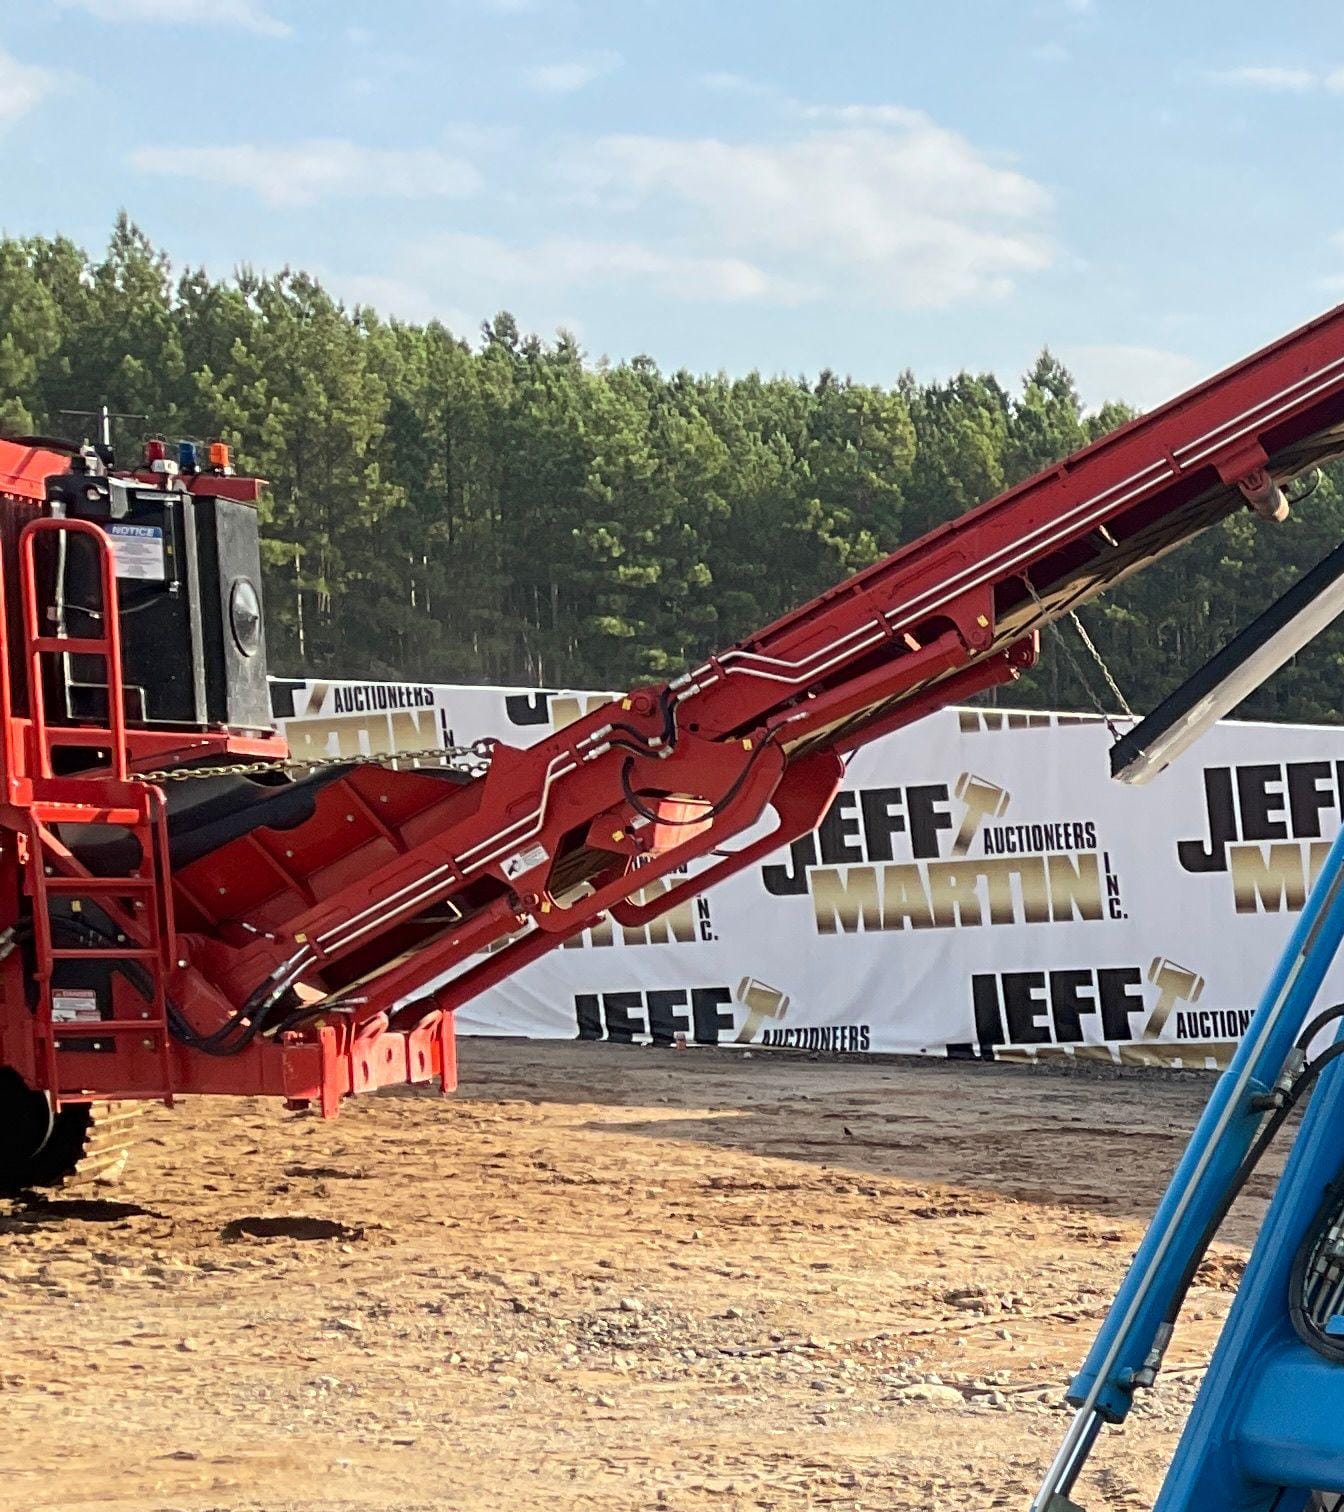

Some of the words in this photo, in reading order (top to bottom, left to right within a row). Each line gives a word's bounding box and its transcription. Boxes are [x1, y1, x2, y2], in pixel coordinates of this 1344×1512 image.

[112, 526, 154, 537] NOTICE
[334, 686, 435, 713] AUCTIONEERS
[762, 783, 952, 896] JEFF
[983, 822, 1097, 855] AUCTIONEERS
[809, 852, 1105, 936] MARTIN
[1103, 851, 1129, 920] INC.
[761, 1024, 870, 1051] AUCTIONEERS
[946, 967, 1145, 1062] JEFF
